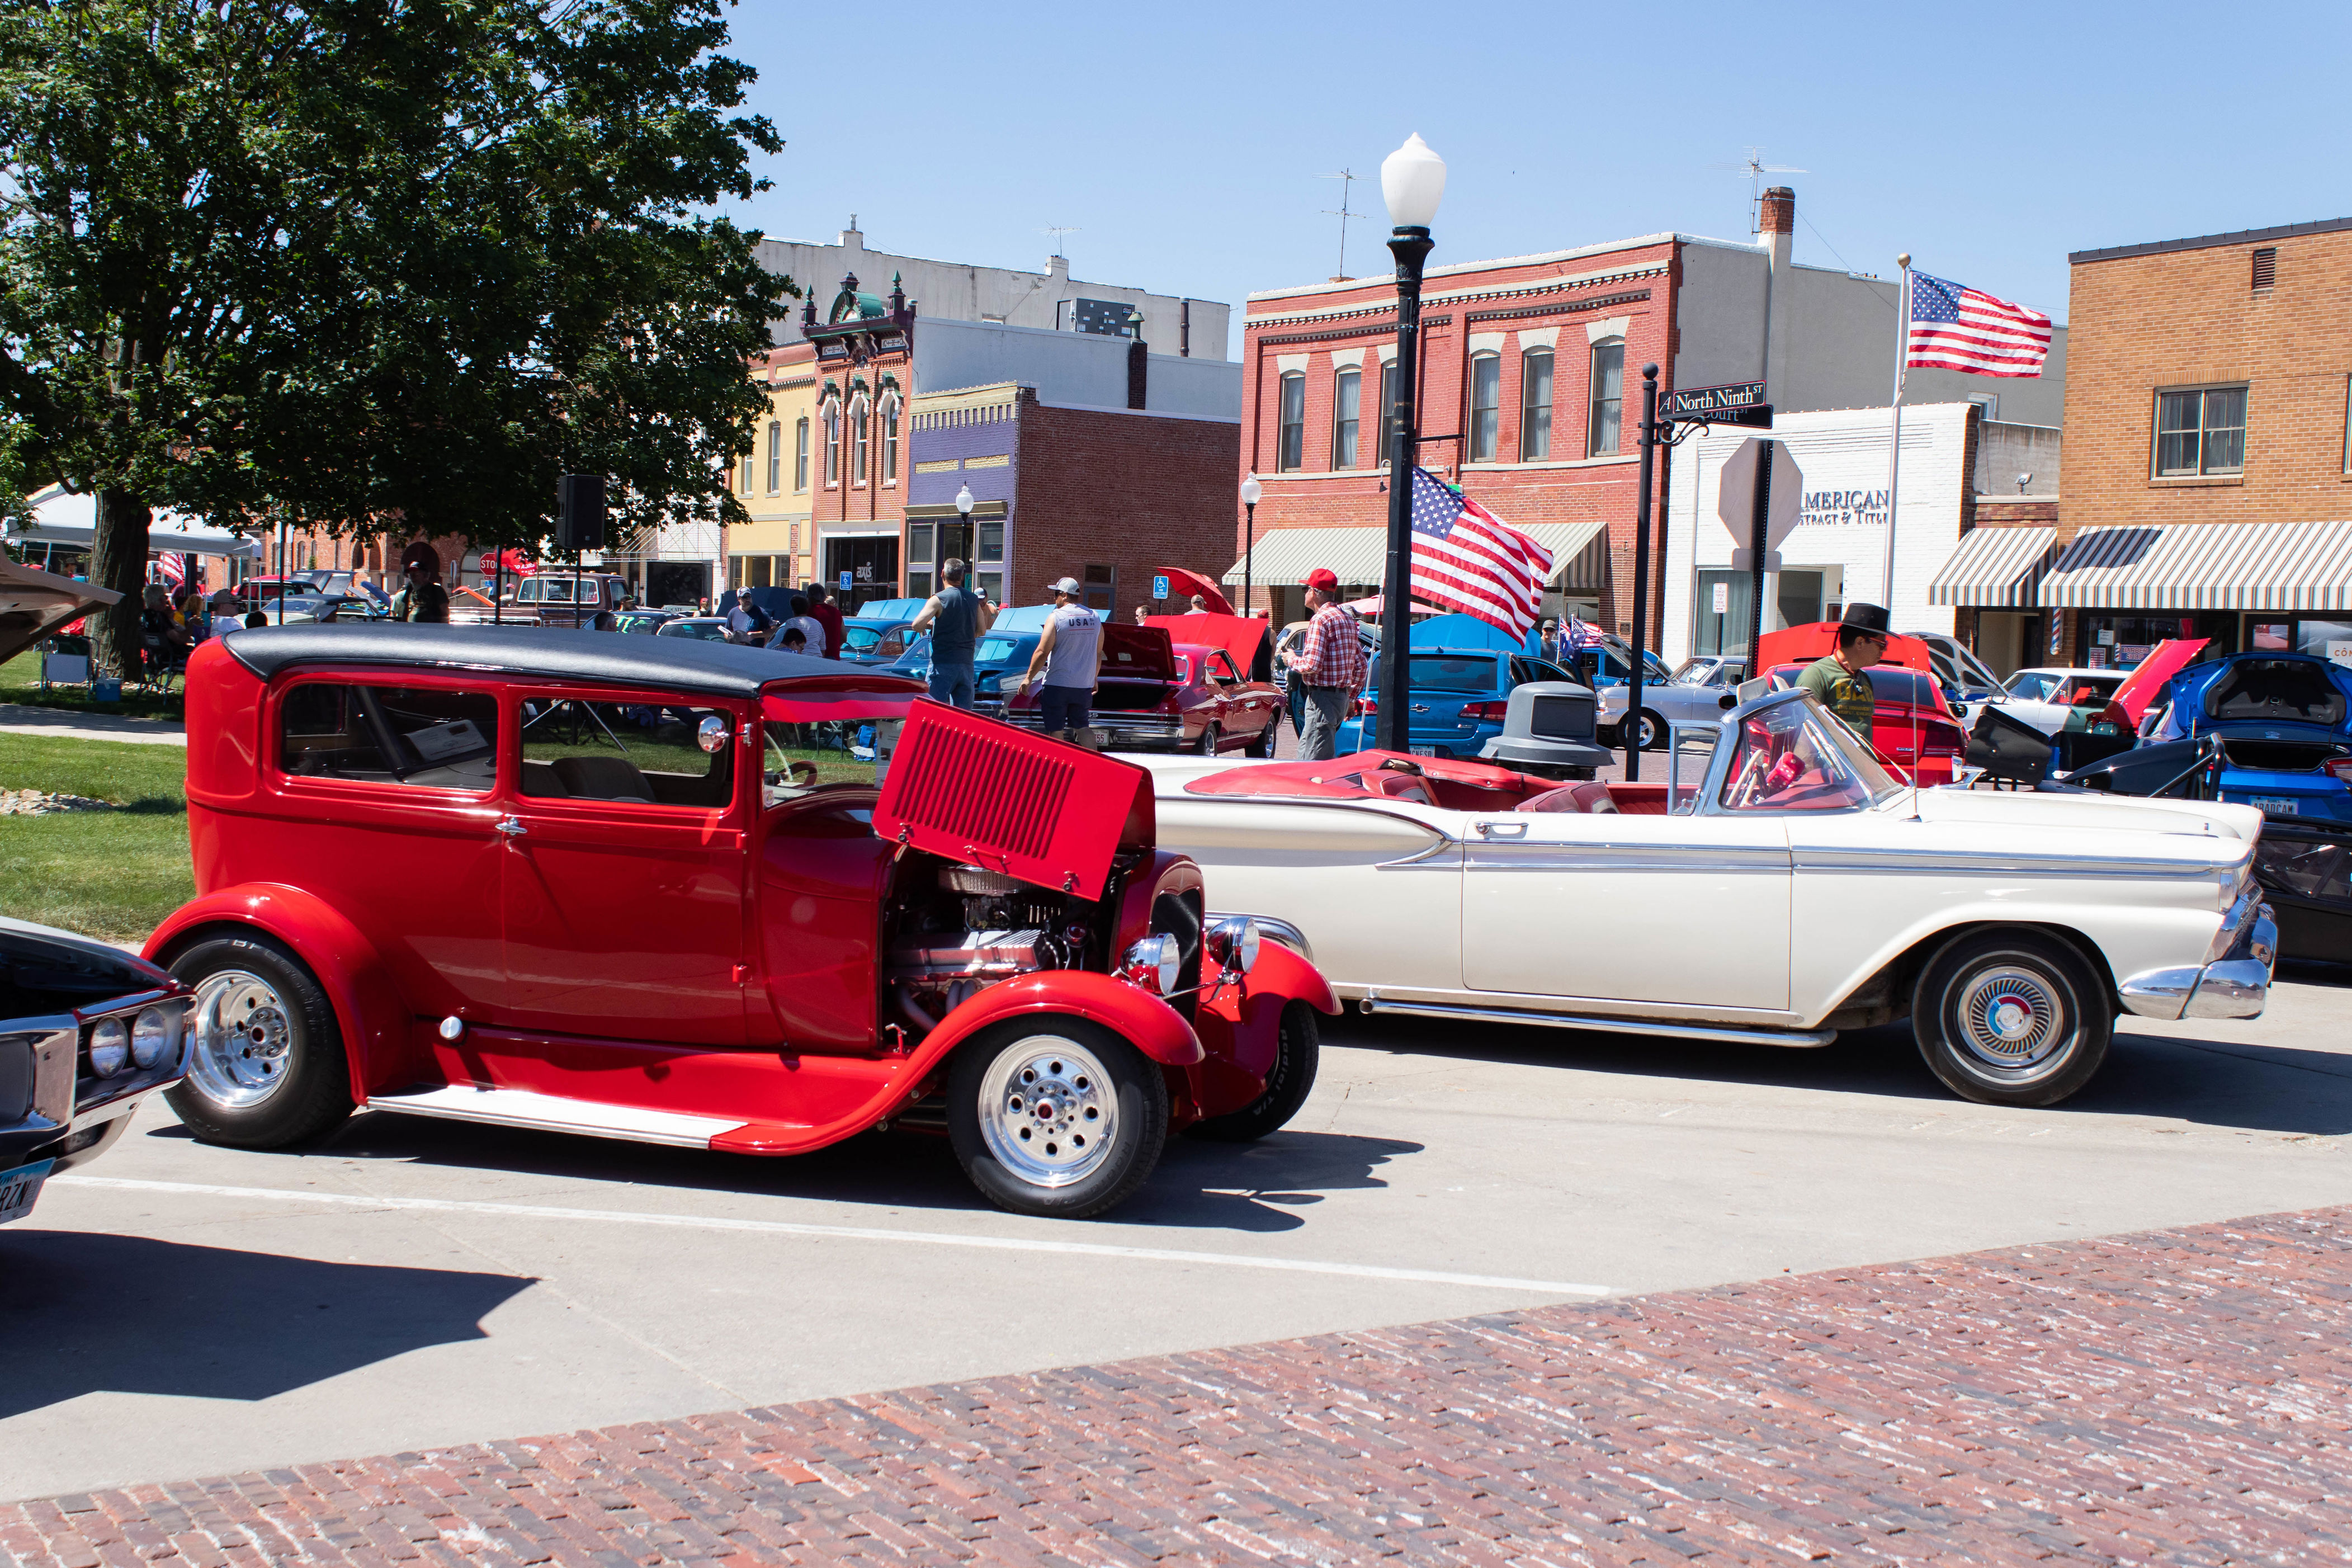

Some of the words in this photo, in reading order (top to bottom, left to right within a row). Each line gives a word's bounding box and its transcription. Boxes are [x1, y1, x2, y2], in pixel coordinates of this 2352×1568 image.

[1675, 391, 1713, 412] North
[1716, 386, 1753, 407] Ninth
[1753, 385, 1763, 394] ST
[1801, 490, 1888, 511] MERICAN
[1799, 513, 1838, 526] STRACT
[481, 560, 497, 569] STO
[856, 561, 872, 581] axis
[1096, 734, 1104, 743] 55
[0, 1179, 32, 1212] RZN
